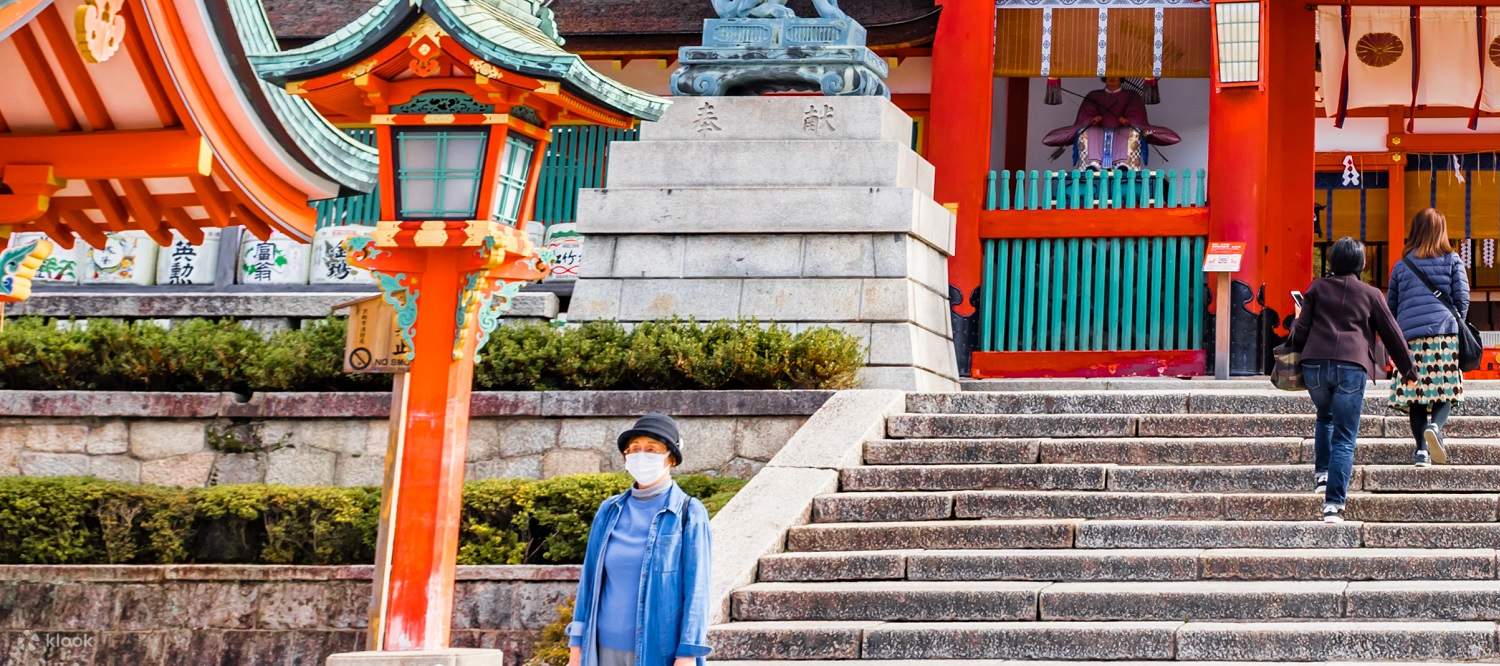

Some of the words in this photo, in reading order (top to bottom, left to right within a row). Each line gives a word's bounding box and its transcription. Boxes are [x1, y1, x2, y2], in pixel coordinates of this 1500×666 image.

[169, 241, 196, 285] 英勲
[254, 242, 276, 281] 富翁
[374, 358, 388, 366] NO
